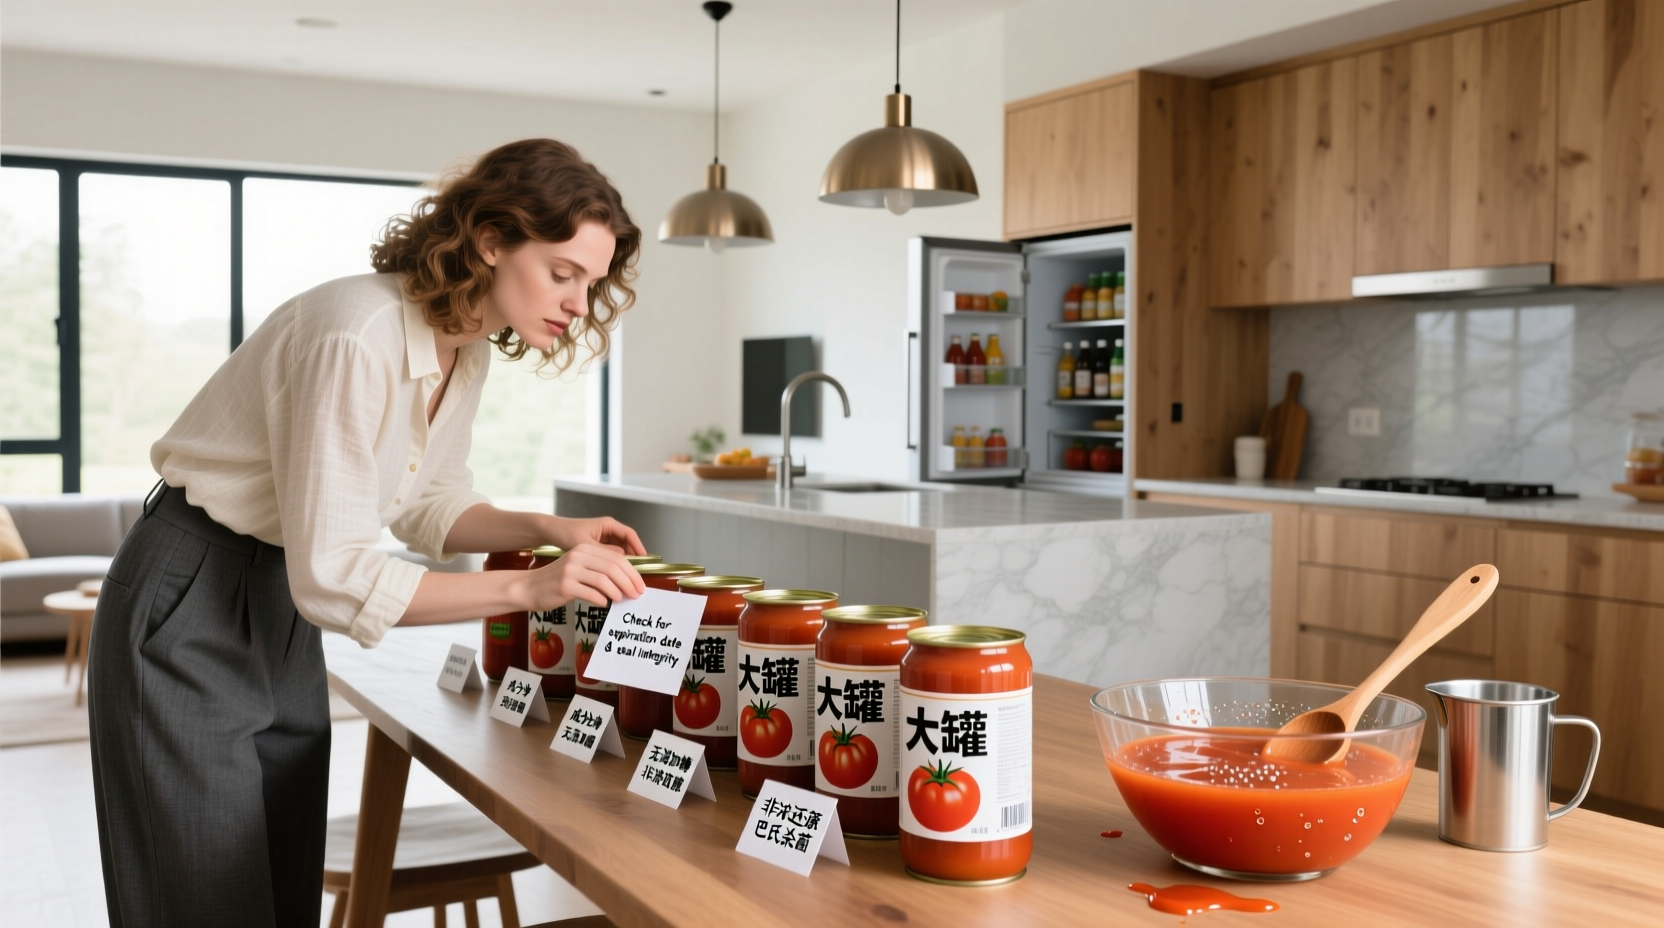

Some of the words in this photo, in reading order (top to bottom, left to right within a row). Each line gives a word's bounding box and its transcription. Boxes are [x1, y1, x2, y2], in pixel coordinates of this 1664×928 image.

[623, 612, 652, 628] Check
[655, 616, 672, 629] for
[687, 636, 727, 673] 罐
[738, 654, 799, 697] 大罐
[817, 676, 885, 723] 大罐
[906, 706, 988, 757] 大罐
